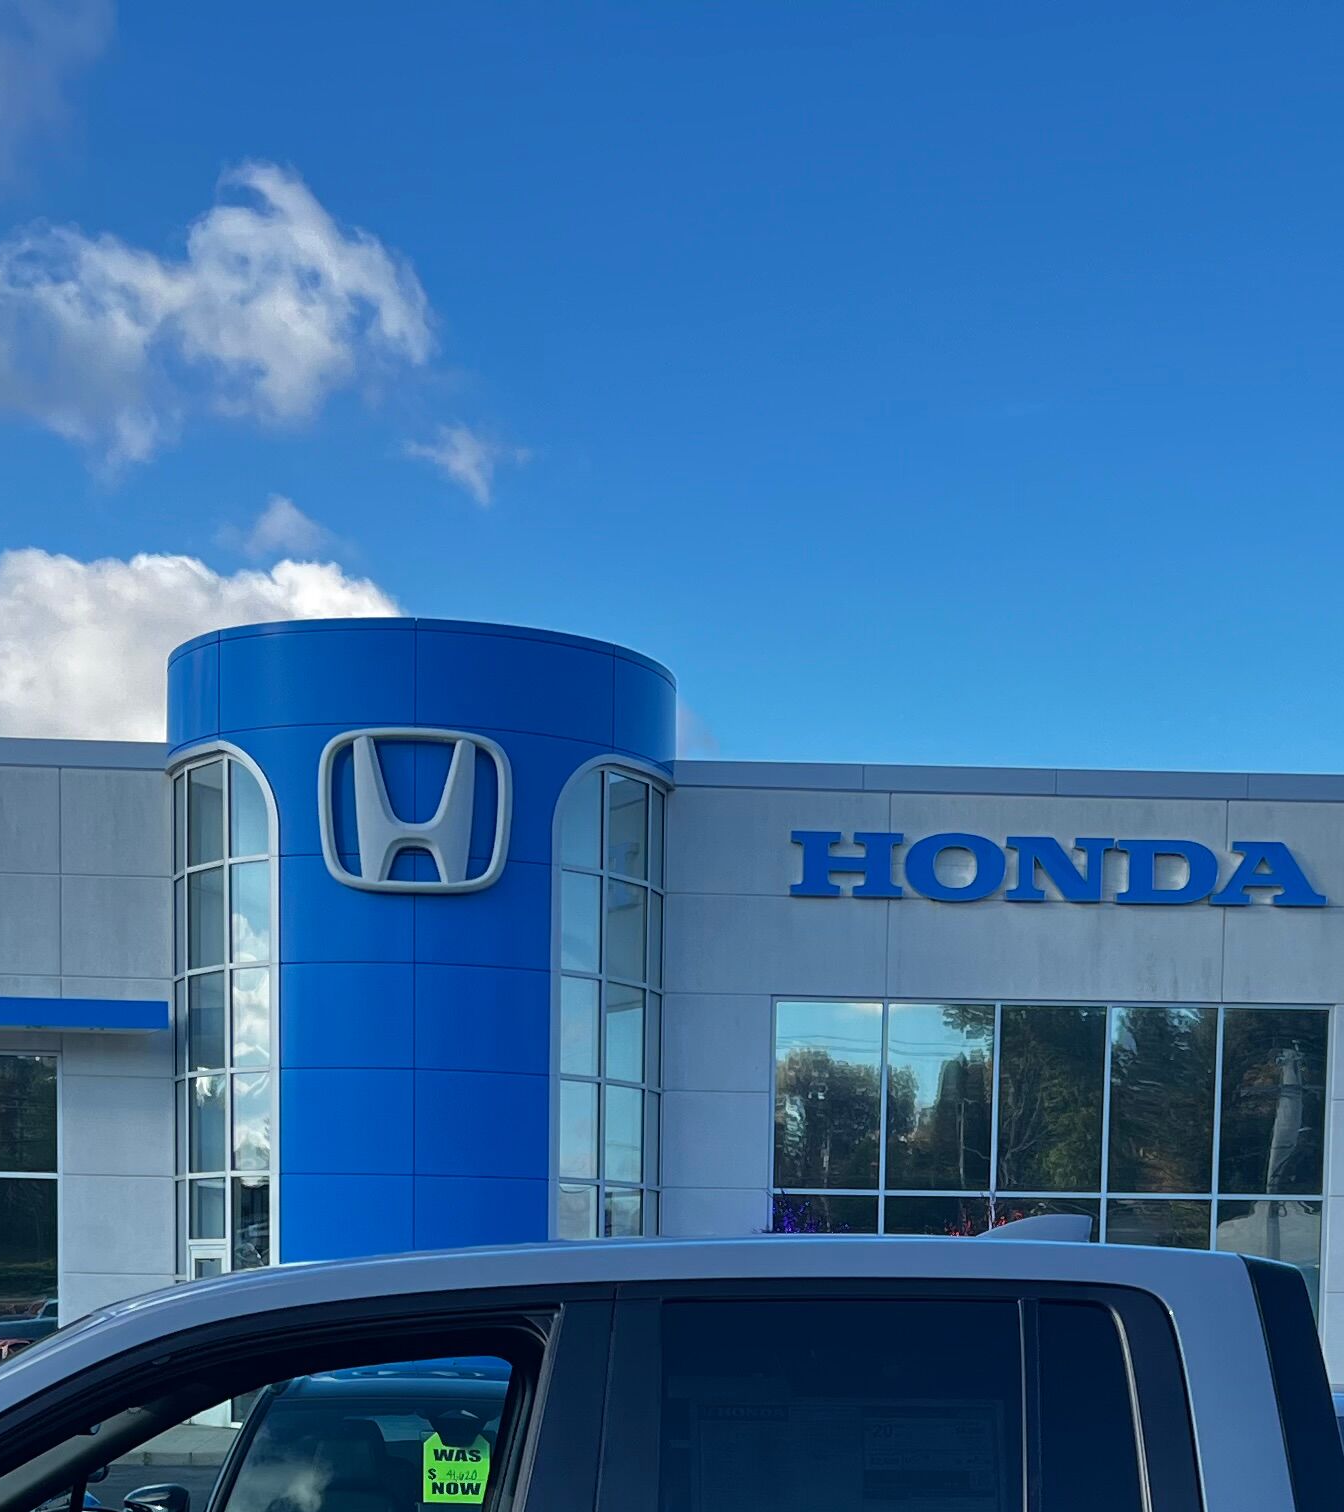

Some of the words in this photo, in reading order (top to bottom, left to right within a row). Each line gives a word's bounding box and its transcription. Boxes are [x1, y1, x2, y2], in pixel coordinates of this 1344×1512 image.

[789, 830, 1328, 906] HONDA
[433, 1448, 482, 1463] WAS
[427, 1467, 437, 1481] $
[431, 1481, 482, 1496] NOW
